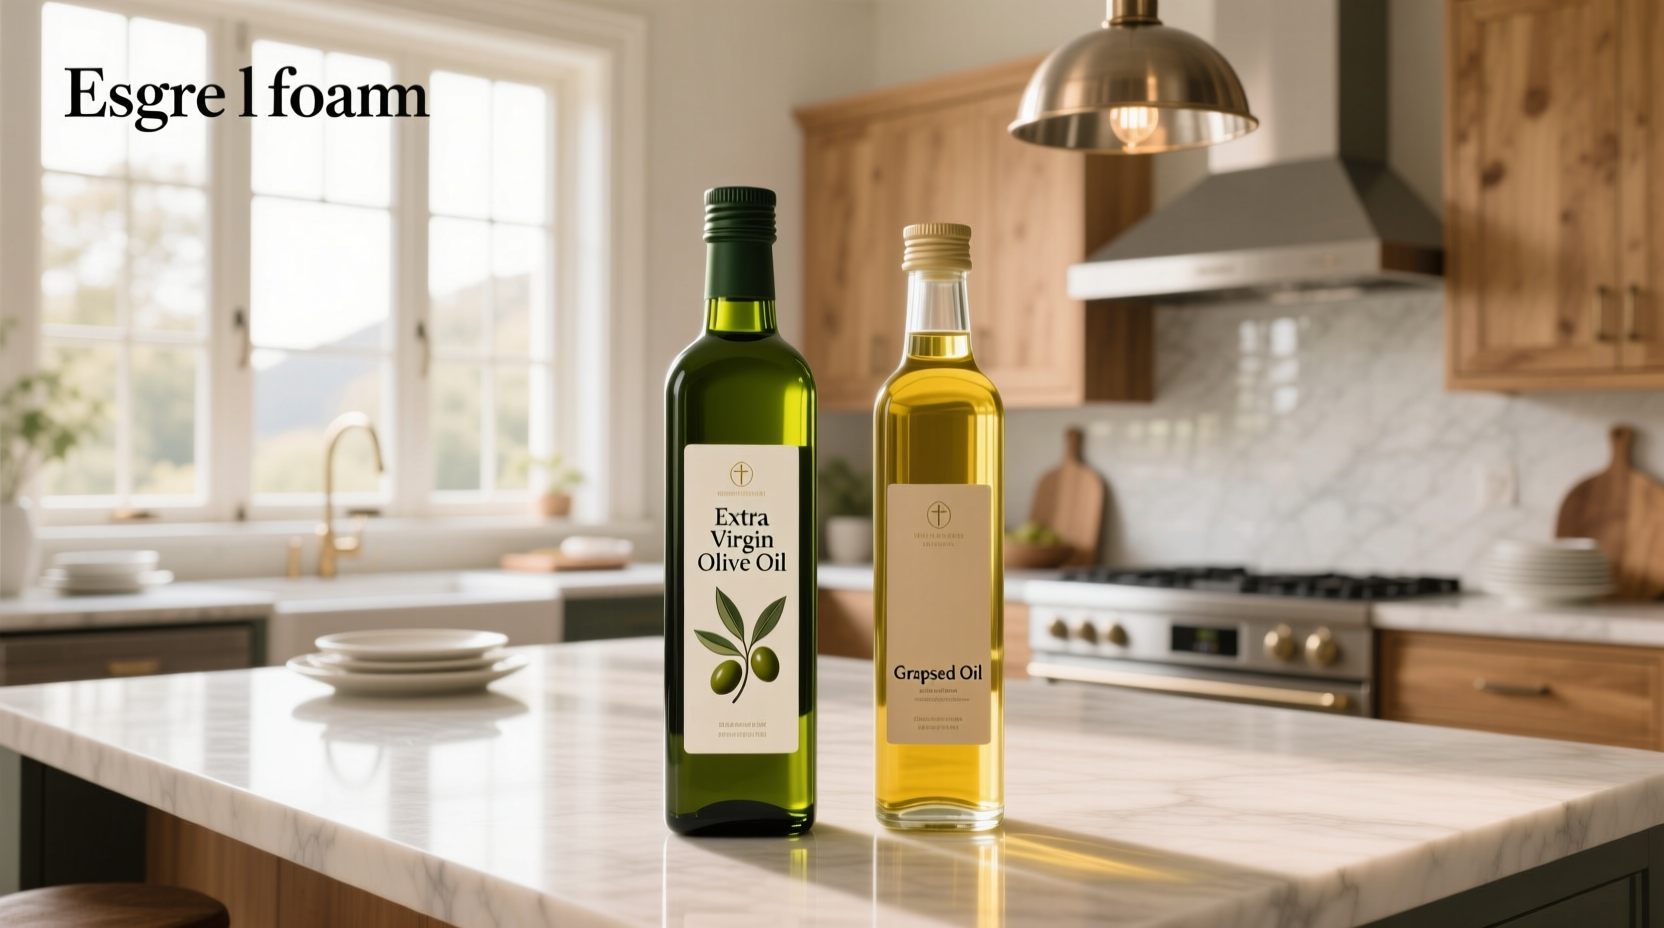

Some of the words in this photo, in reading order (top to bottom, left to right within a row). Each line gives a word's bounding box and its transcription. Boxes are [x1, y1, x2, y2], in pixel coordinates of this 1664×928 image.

[714, 507, 770, 527] Extra
[710, 529, 774, 554] Virgin
[697, 552, 751, 572] Olive
[756, 552, 787, 572] Oil
[959, 664, 983, 680] Oil
